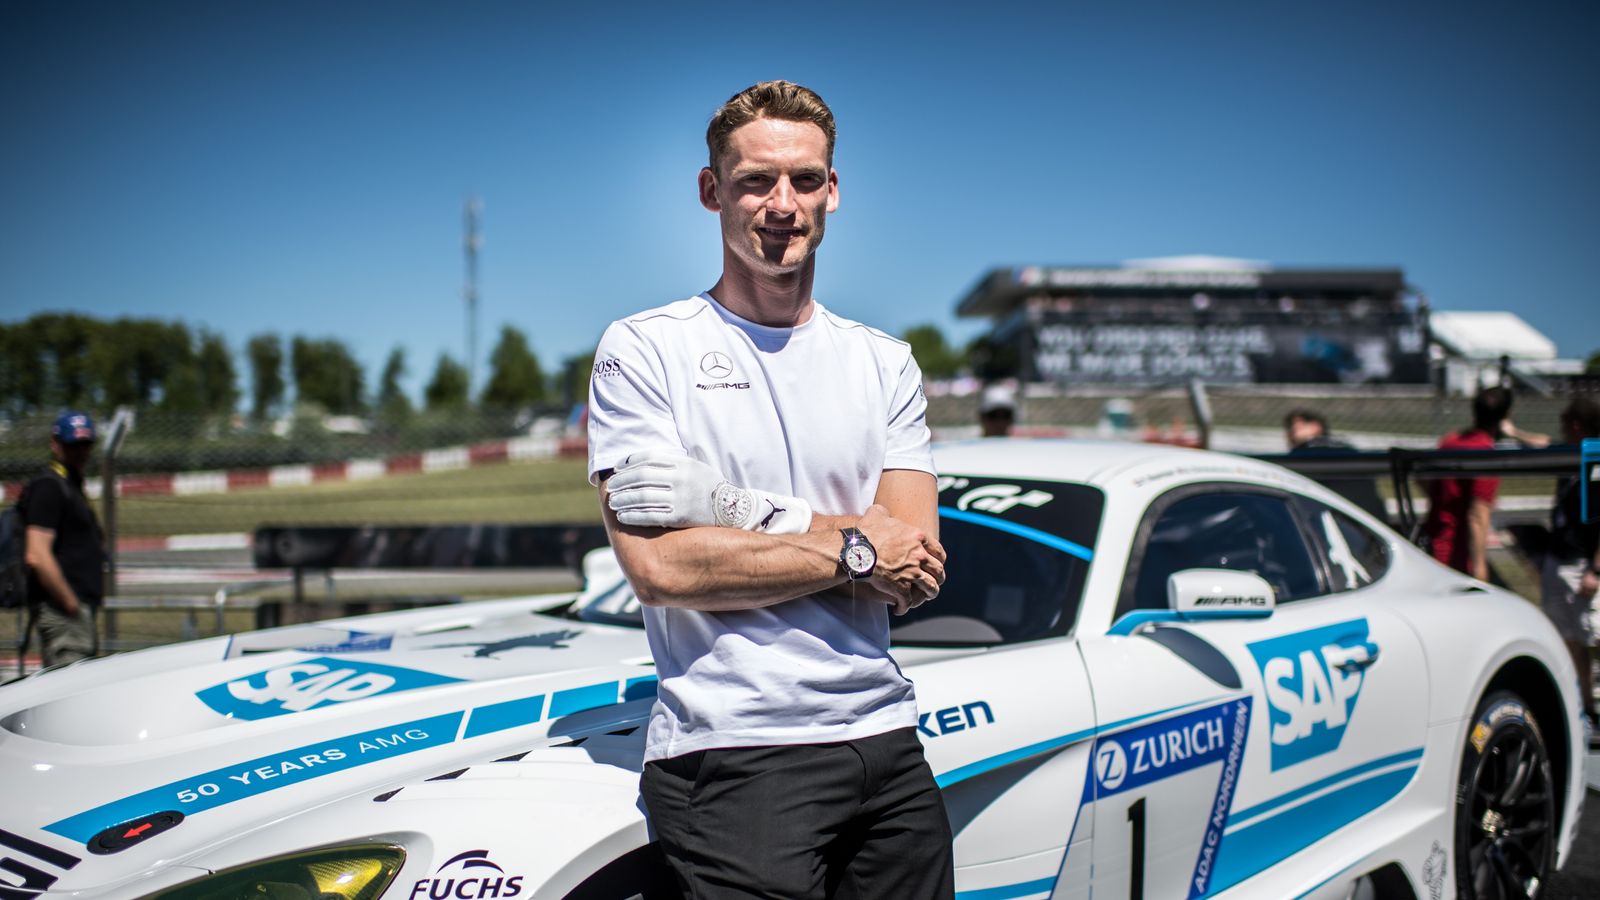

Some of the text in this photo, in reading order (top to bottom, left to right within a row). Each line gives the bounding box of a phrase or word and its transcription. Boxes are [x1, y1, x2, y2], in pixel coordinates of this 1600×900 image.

[711, 382, 751, 390] AMG
[1220, 596, 1266, 606] AMG
[227, 663, 396, 712] SAP
[1264, 644, 1364, 745] SAP
[177, 729, 430, 804] 50 YEARS AMG
[1130, 717, 1225, 775] ZURICH
[1194, 700, 1249, 894] ADAC NORDRHEIN
[1127, 796, 1147, 900] 1
[408, 875, 524, 900] FUCHS
